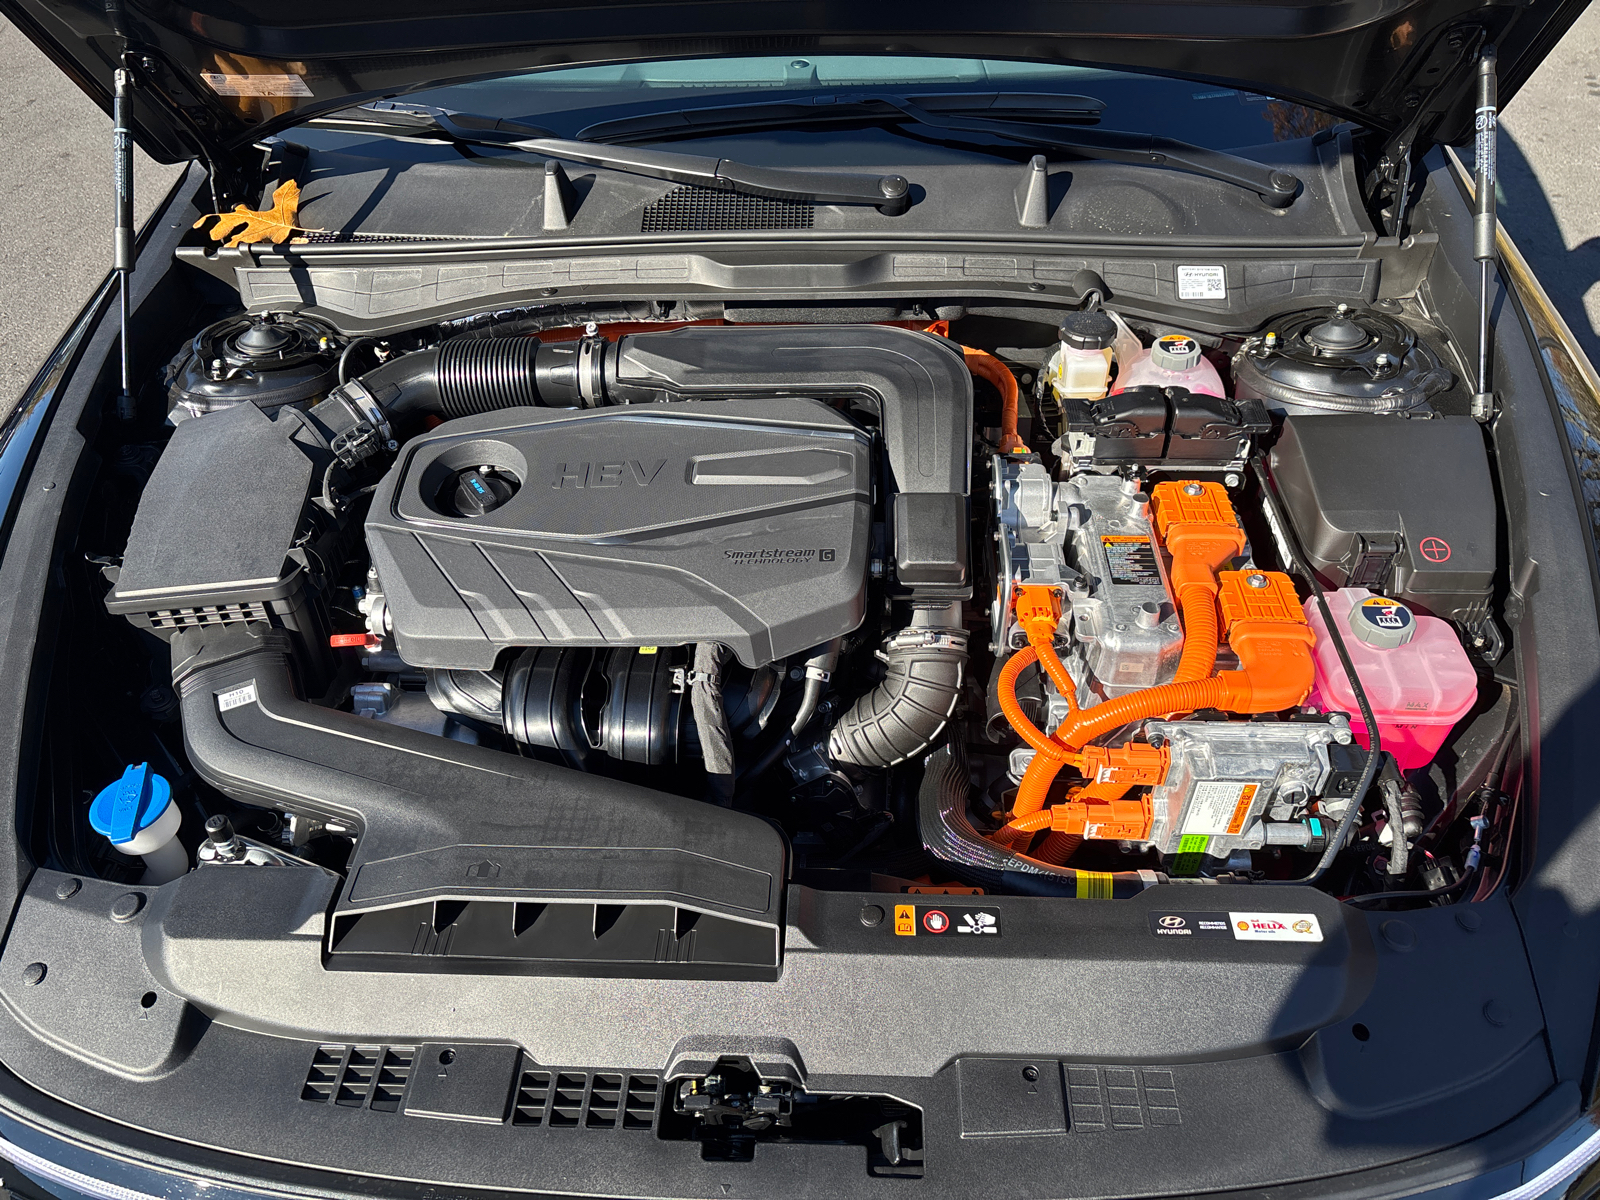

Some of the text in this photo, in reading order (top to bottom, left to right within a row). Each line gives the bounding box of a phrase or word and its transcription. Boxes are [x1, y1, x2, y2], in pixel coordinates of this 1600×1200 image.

[551, 458, 668, 489] HEV
[722, 548, 816, 559] Smartstream
[734, 557, 812, 565] TECHNOLOGY
